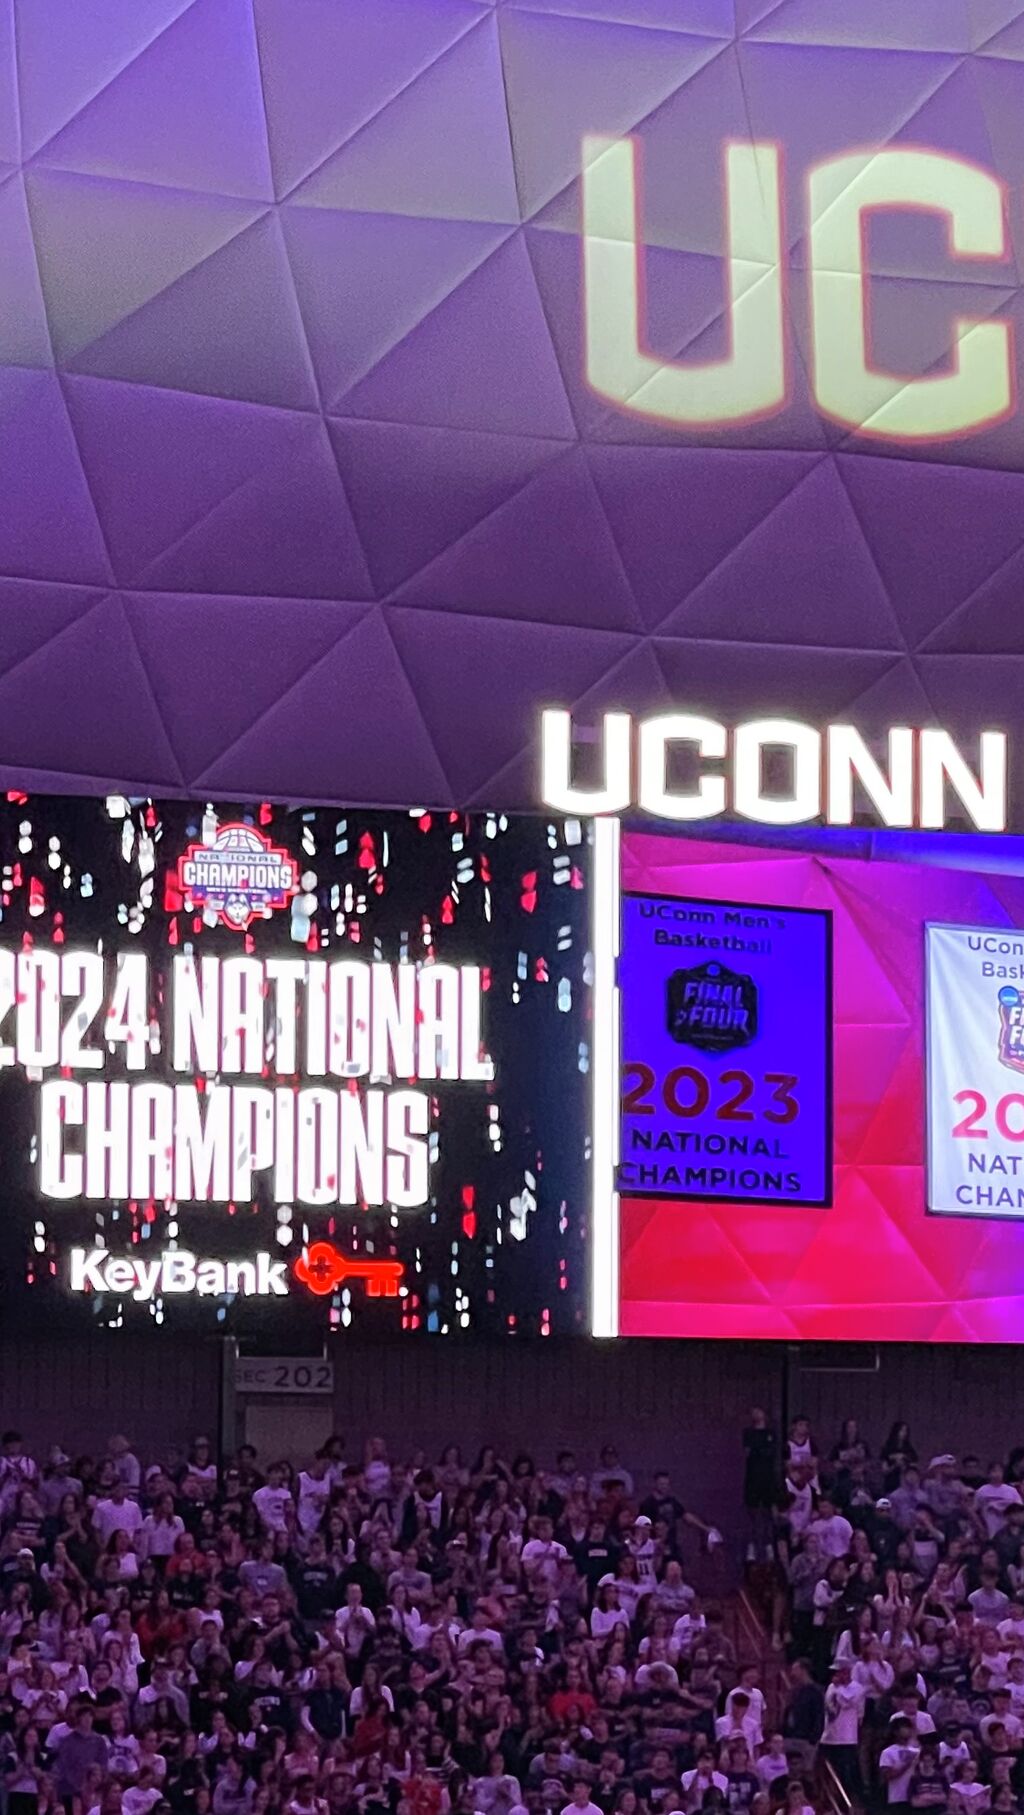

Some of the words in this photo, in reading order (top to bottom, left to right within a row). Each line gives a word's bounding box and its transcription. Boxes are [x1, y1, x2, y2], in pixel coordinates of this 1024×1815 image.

[540, 709, 1008, 832] UCONN
[183, 861, 293, 889] CHAMPIONS
[640, 902, 716, 924] UConn
[654, 928, 773, 954] Basketball
[173, 955, 494, 1080] NATIONAL
[621, 1062, 800, 1125] 2023
[40, 1080, 429, 1206] CHAMPIONS
[631, 1128, 790, 1160] NATIONAL
[618, 1160, 802, 1193] CHAMPIONS
[69, 1248, 289, 1300] KeyBank
[273, 1365, 331, 1388] 202
